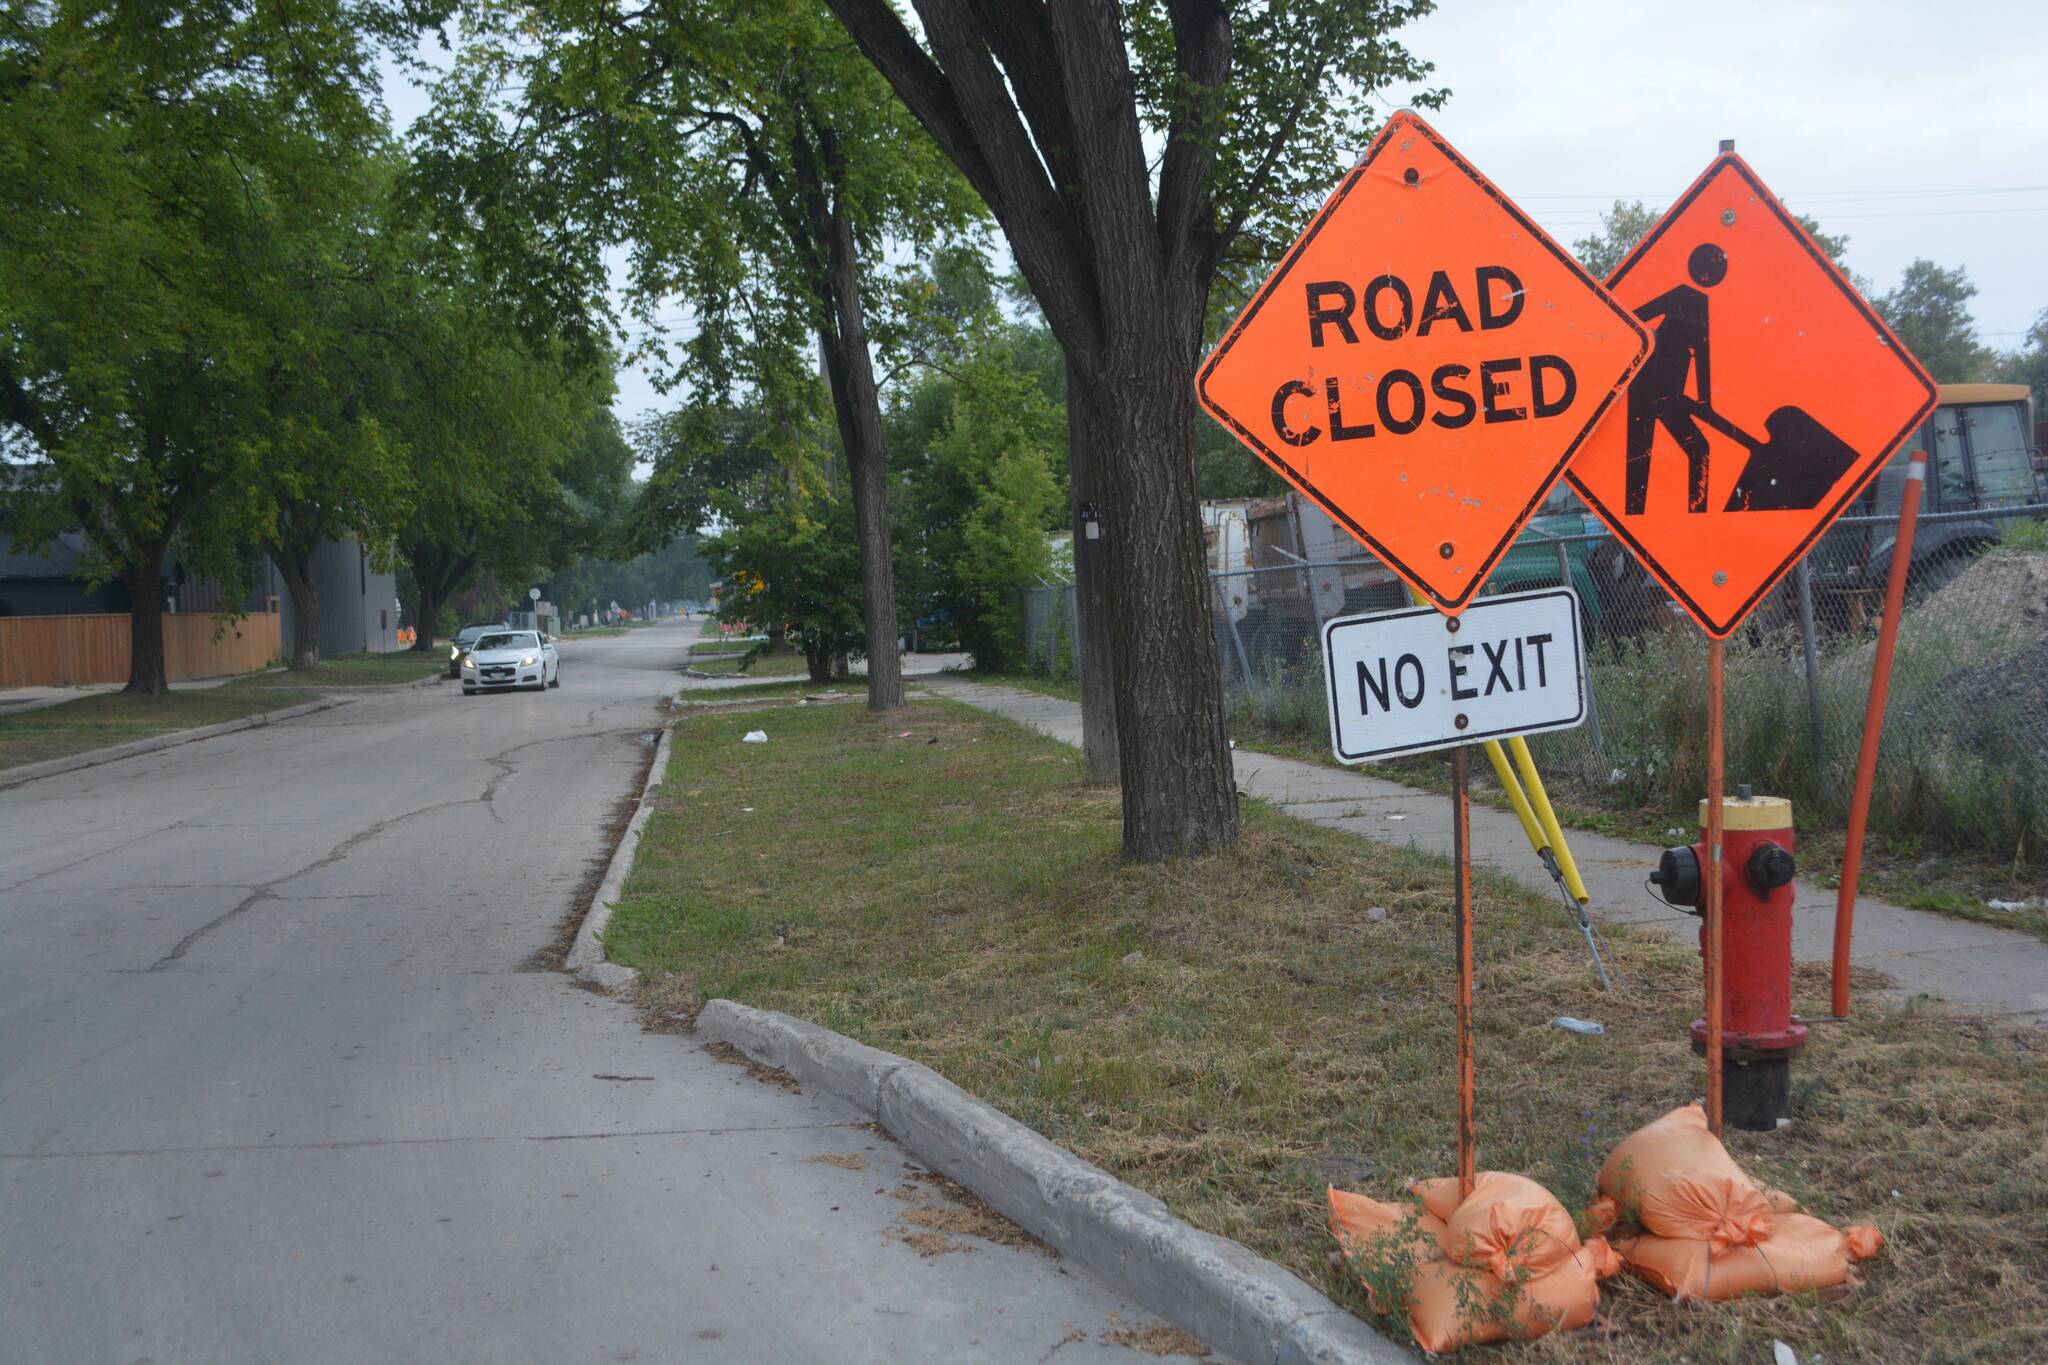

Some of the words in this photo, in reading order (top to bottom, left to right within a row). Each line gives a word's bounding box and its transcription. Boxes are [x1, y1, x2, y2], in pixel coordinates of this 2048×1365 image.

[1305, 265, 1525, 348] ROAD
[1271, 354, 1577, 447] CLOSED
[1356, 653, 1425, 716] NO
[1448, 633, 1552, 701] EXIT
